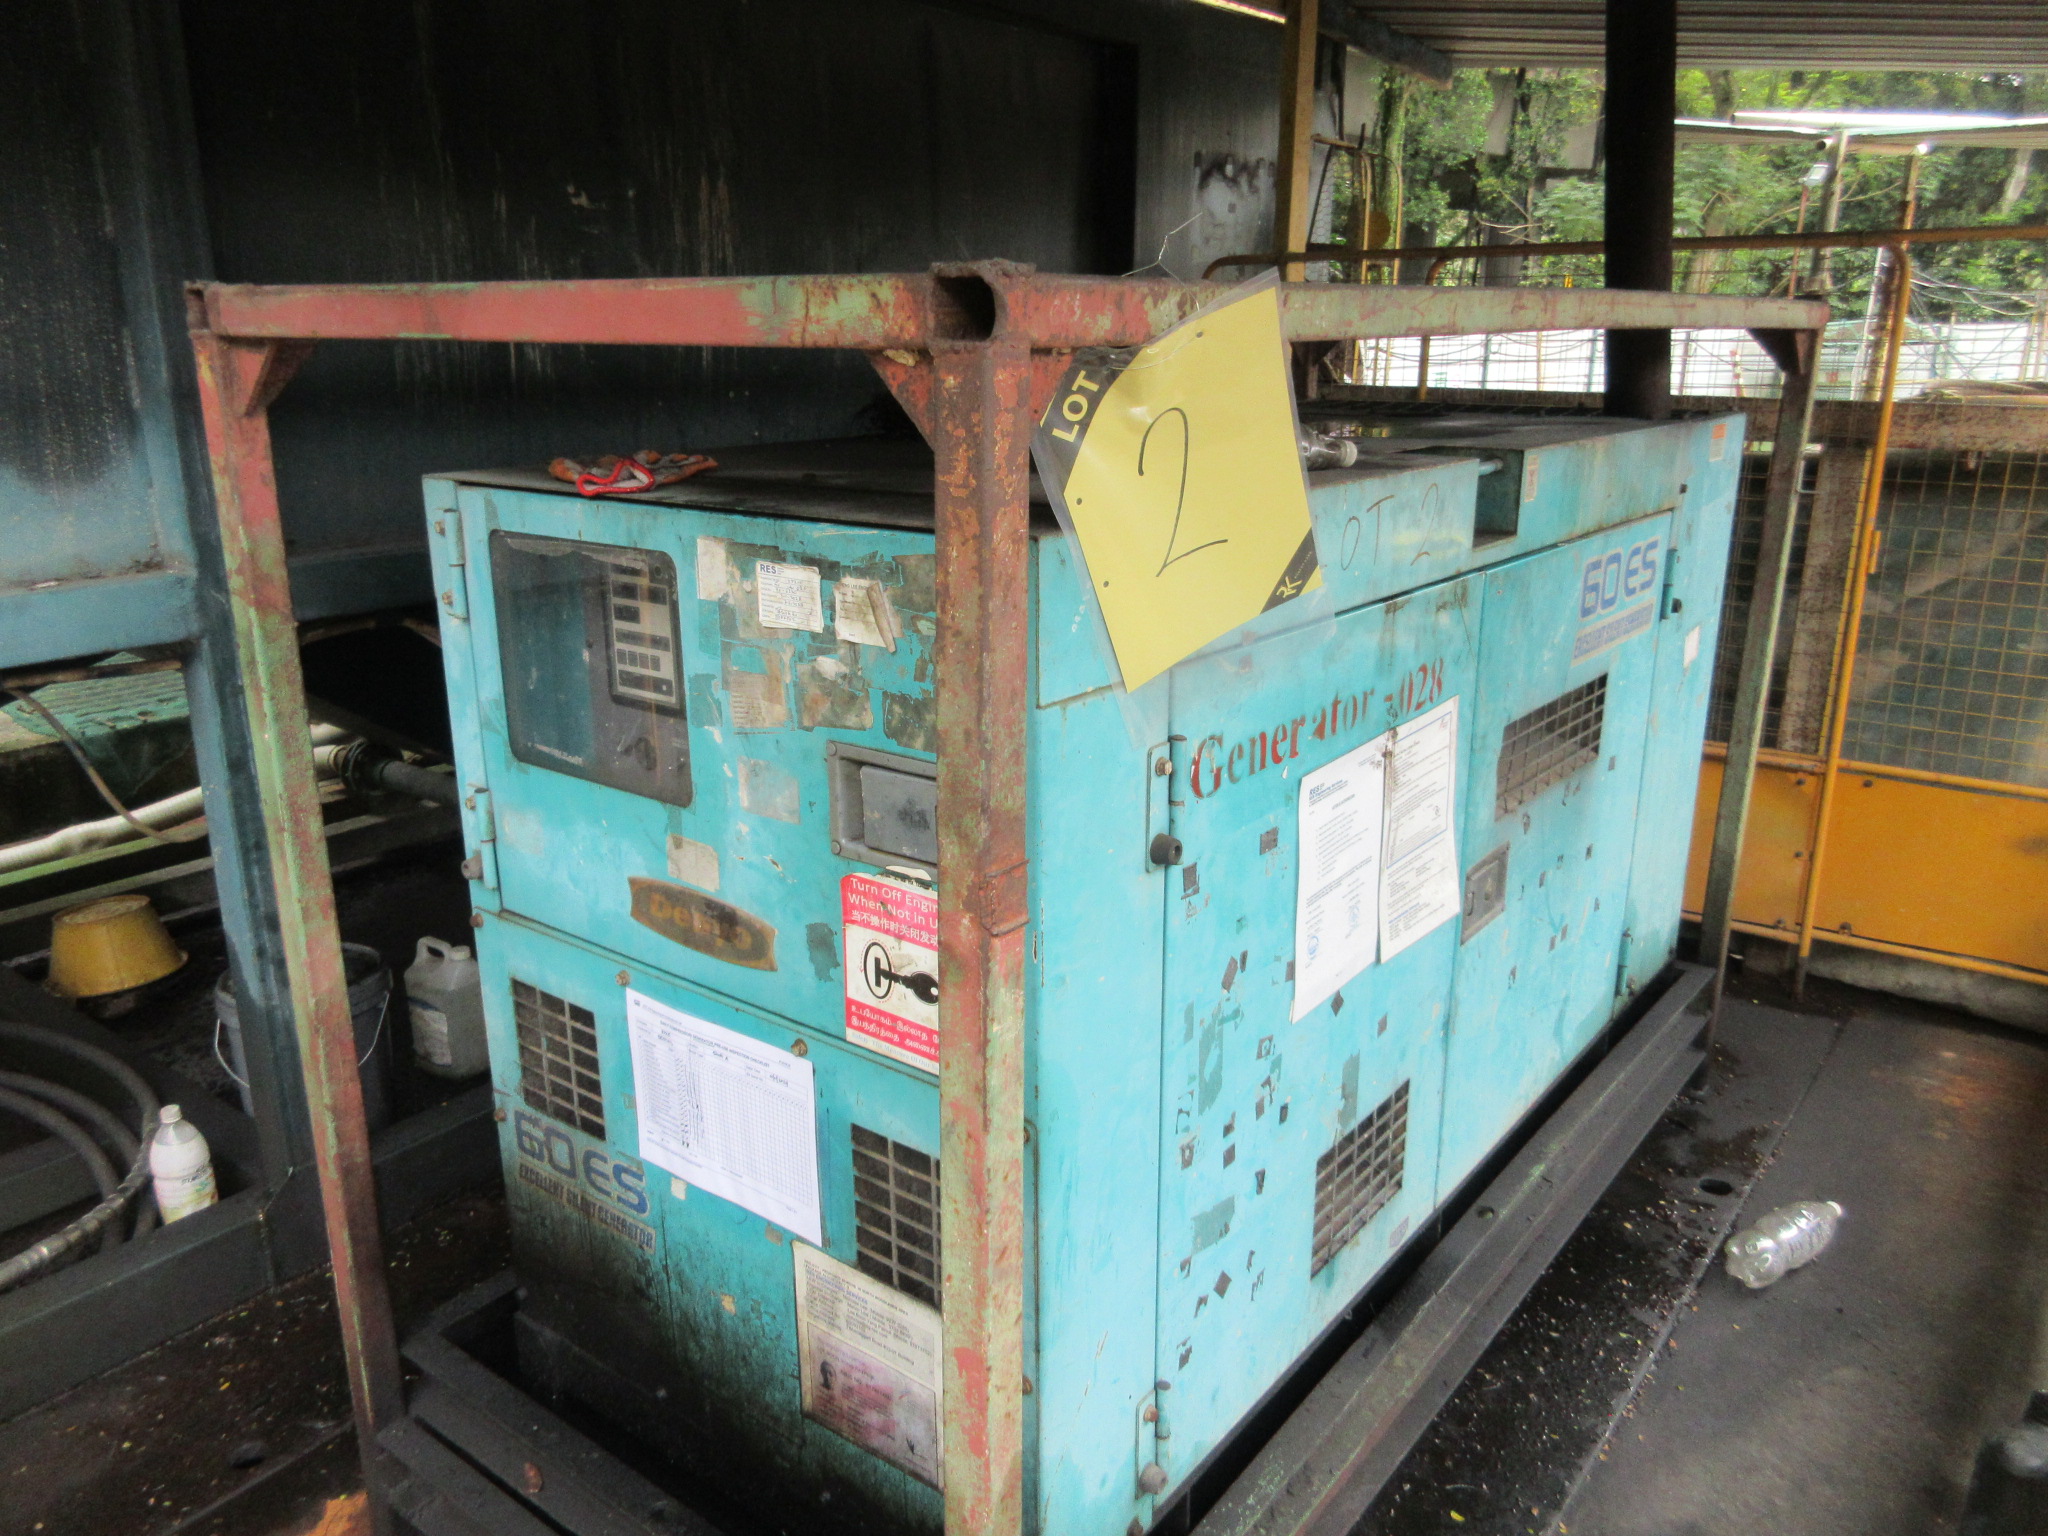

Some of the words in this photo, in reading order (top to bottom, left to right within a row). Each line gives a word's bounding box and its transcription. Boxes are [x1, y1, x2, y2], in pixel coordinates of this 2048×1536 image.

[1052, 370, 1100, 443] LOT
[1138, 407, 1229, 578] 2
[1341, 494, 1395, 571] OT
[1410, 482, 1439, 567] 2
[760, 563, 777, 575] RES
[1190, 689, 1375, 798] Generator
[848, 892, 883, 912] When
[887, 903, 911, 921] Not
[850, 877, 878, 895] Turn
[881, 887, 902, 902] Off
